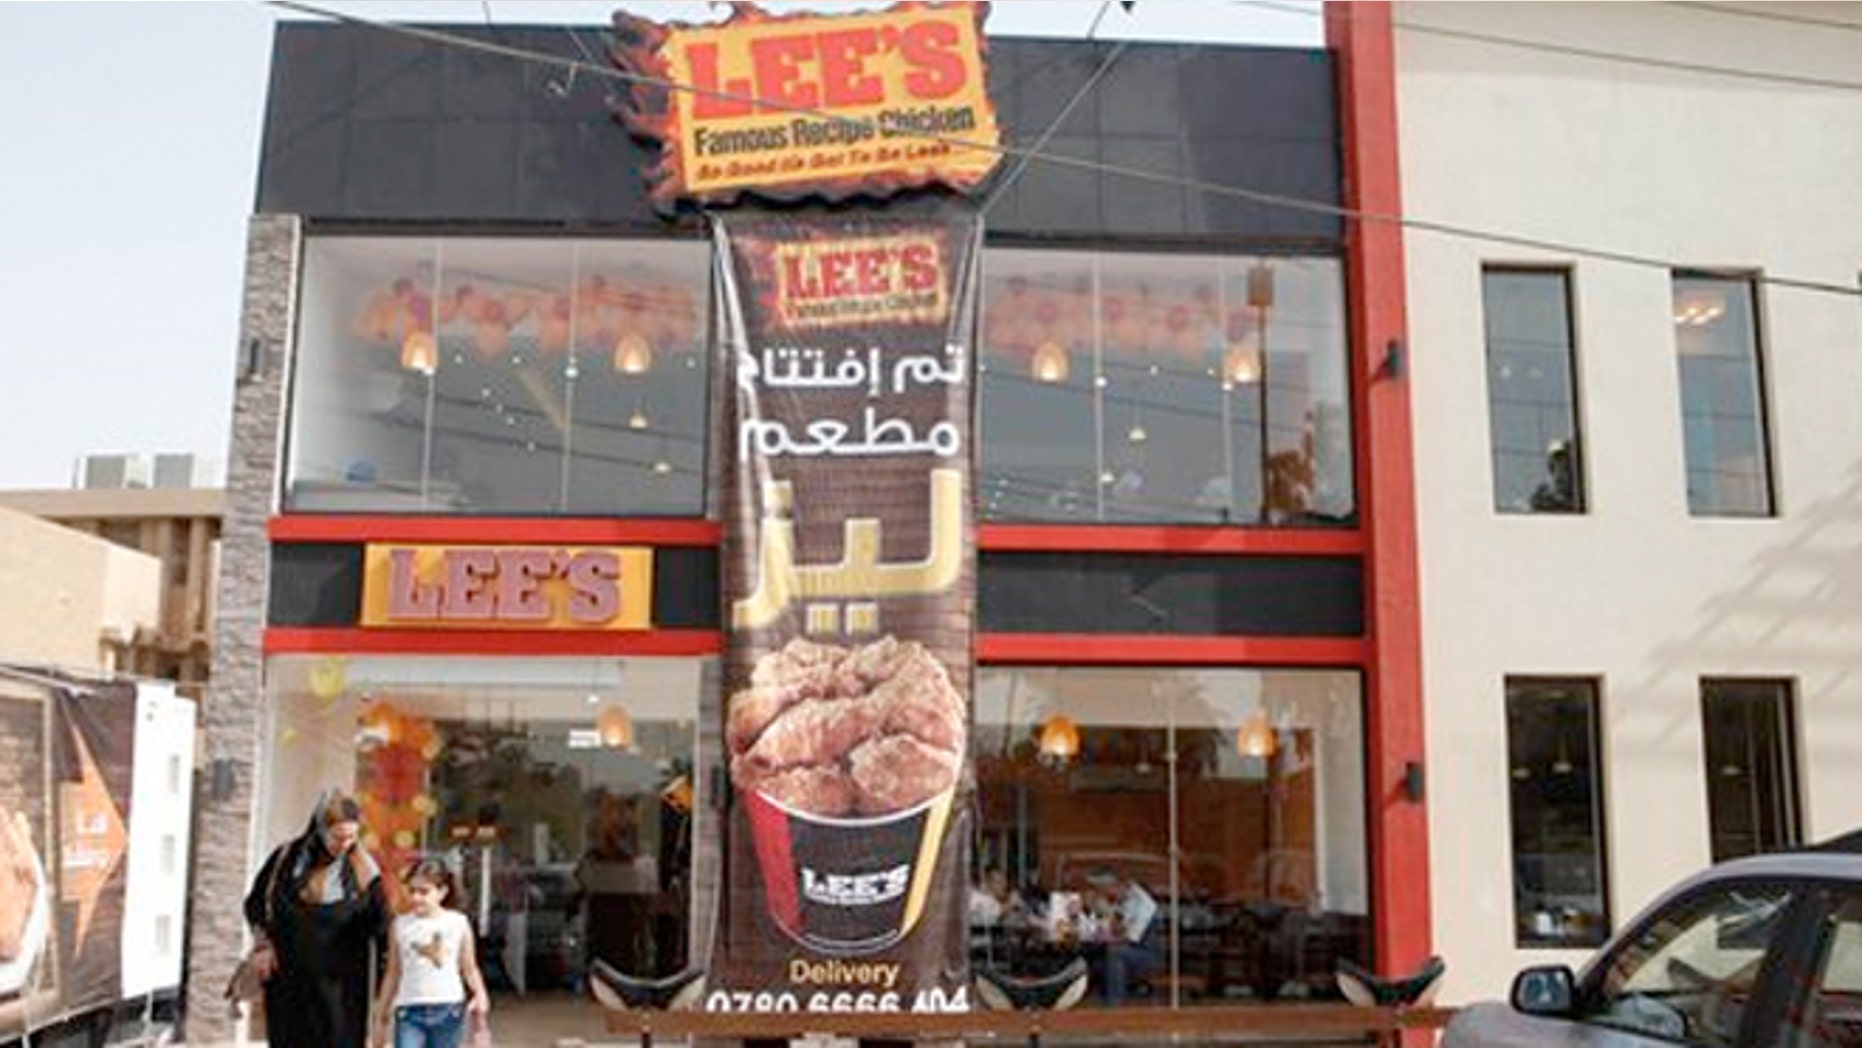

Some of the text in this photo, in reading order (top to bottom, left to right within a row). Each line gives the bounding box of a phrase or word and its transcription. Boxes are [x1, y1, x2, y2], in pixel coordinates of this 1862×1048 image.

[687, 21, 967, 119] LEE'S
[694, 106, 975, 156] Famous Recipe Chicken
[784, 243, 938, 299] LEE'S
[894, 344, 964, 393] تم
[739, 406, 961, 463] مطعم
[732, 468, 963, 635] ليز
[388, 548, 621, 624] LEE'S
[789, 959, 899, 987] Delivery
